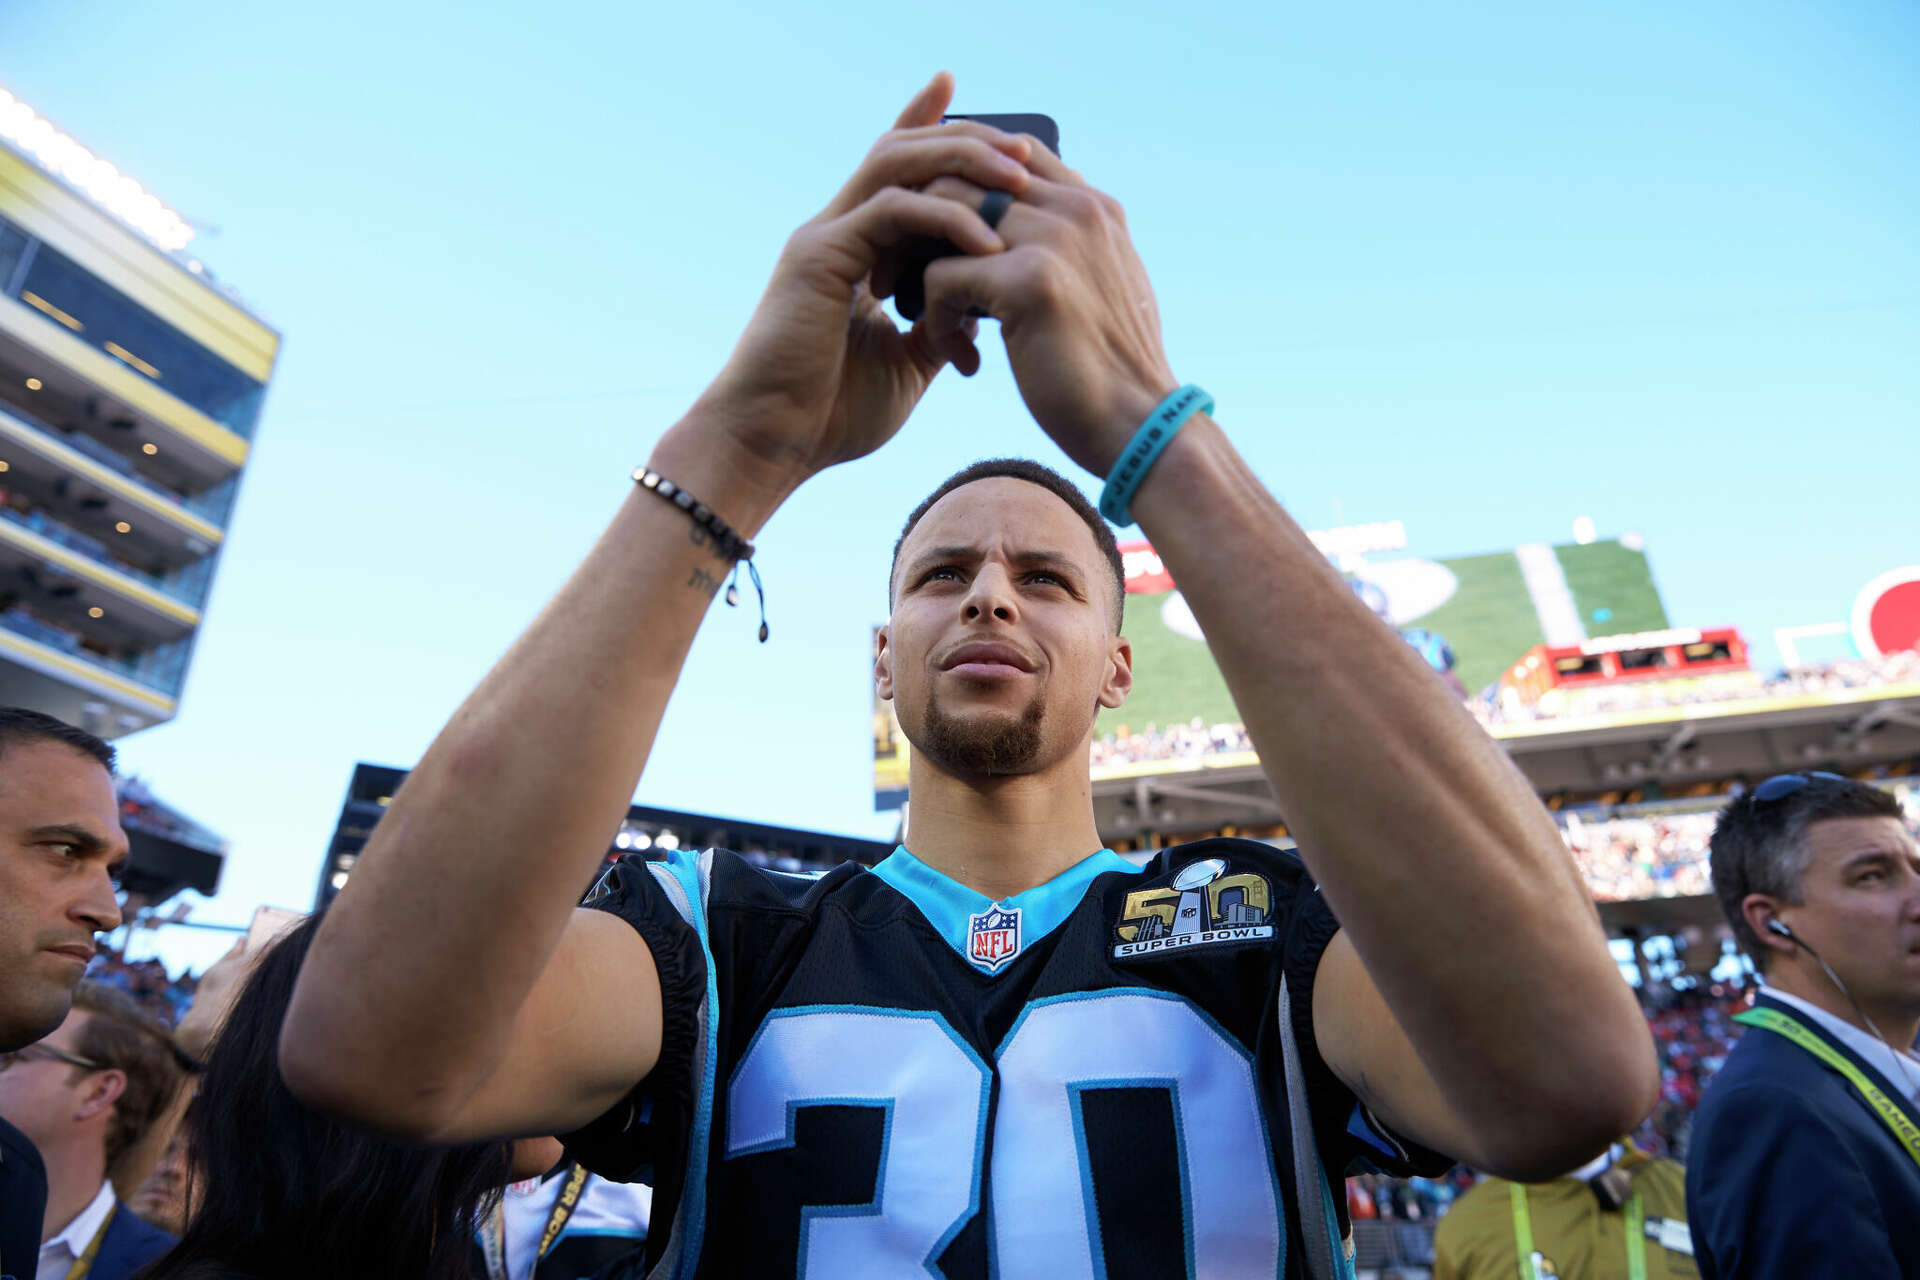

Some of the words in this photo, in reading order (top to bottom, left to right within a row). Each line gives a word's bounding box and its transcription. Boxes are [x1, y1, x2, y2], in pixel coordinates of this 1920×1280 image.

[1112, 426, 1163, 496] JESUS
[975, 930, 1014, 959] NFL
[1121, 935, 1193, 955] SUPER
[1202, 928, 1265, 943] BOWL
[723, 986, 1287, 1280] 30
